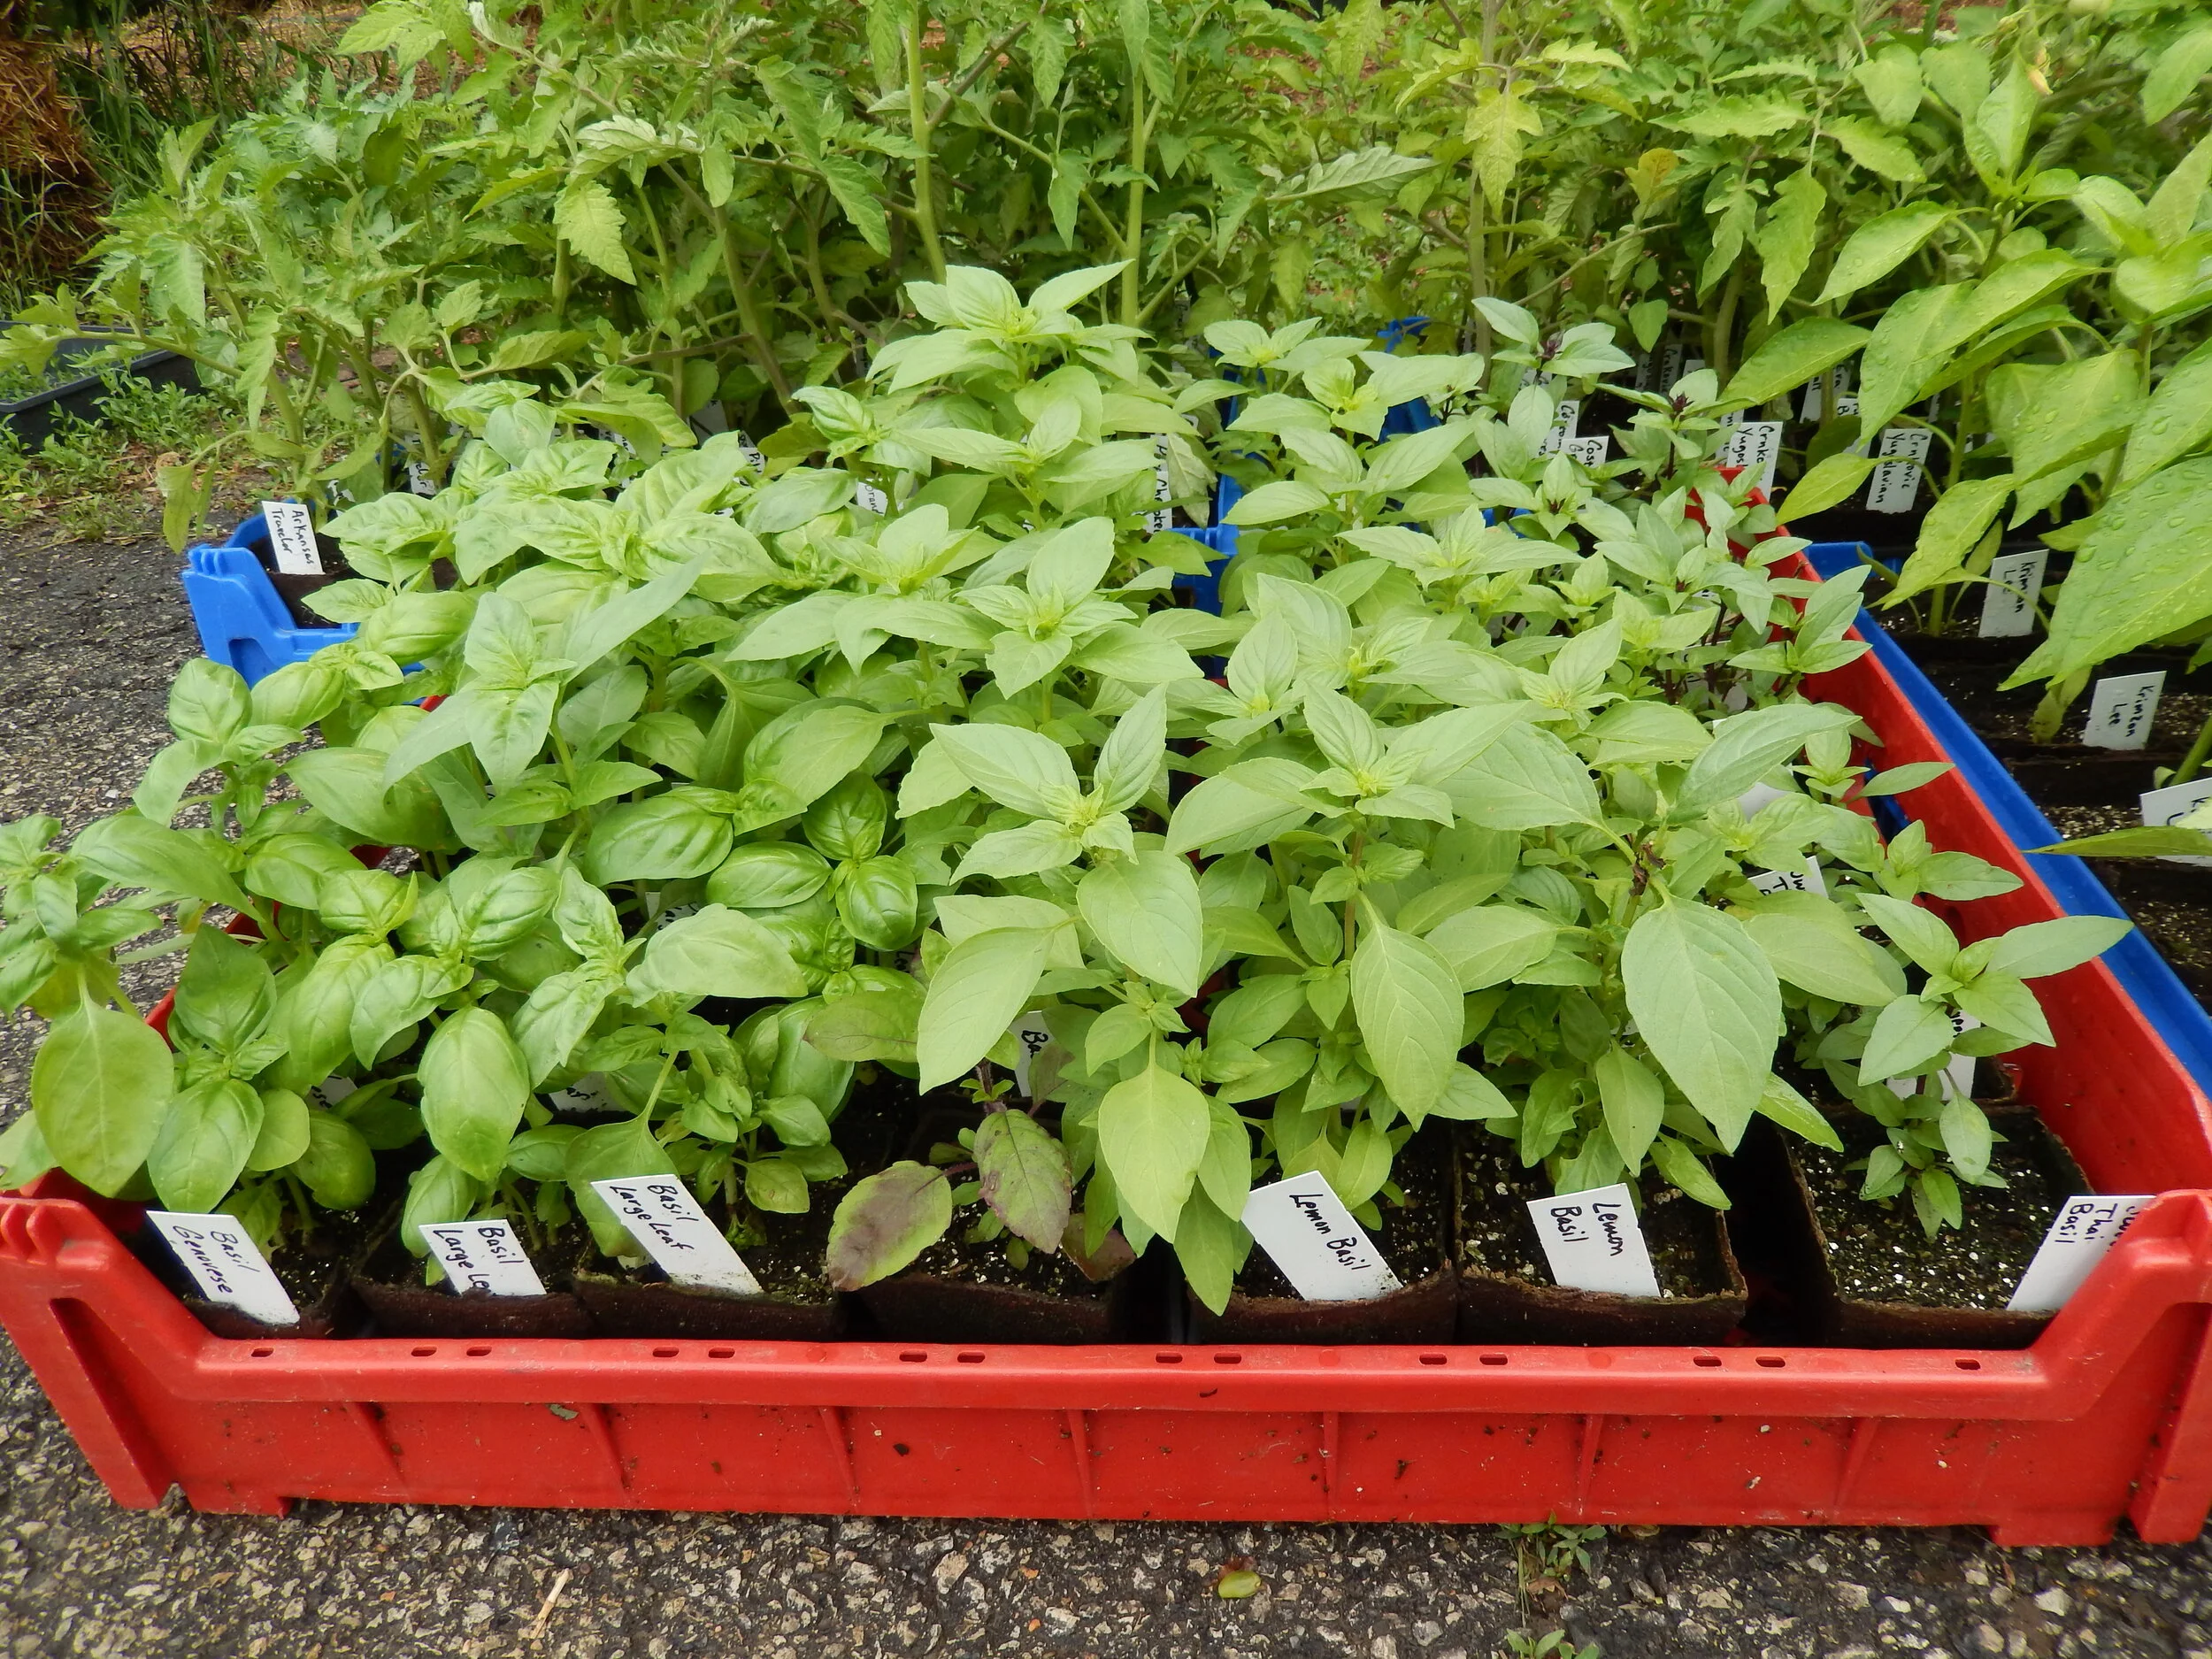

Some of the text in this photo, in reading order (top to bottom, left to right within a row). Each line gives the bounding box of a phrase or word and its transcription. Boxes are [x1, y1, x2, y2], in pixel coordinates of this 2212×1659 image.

[1732, 428, 1754, 467] Yugosl
[1876, 433, 1905, 503] Yugslavian
[2108, 703, 2129, 726] Lee
[2125, 685, 2155, 738] Krimzon
[609, 1186, 695, 1250] Large Leaf
[647, 1185, 699, 1222] Basil
[2055, 1203, 2094, 1243] Basil
[2084, 1202, 2118, 1240] Thai
[1289, 1194, 1371, 1271] Lemon Basil
[1550, 1206, 1589, 1242] Basil
[1593, 1202, 1624, 1256] Lemon
[173, 1225, 234, 1294] Genovese
[210, 1231, 261, 1273] Basil
[433, 1230, 474, 1269] Large
[478, 1227, 525, 1263] Basil
